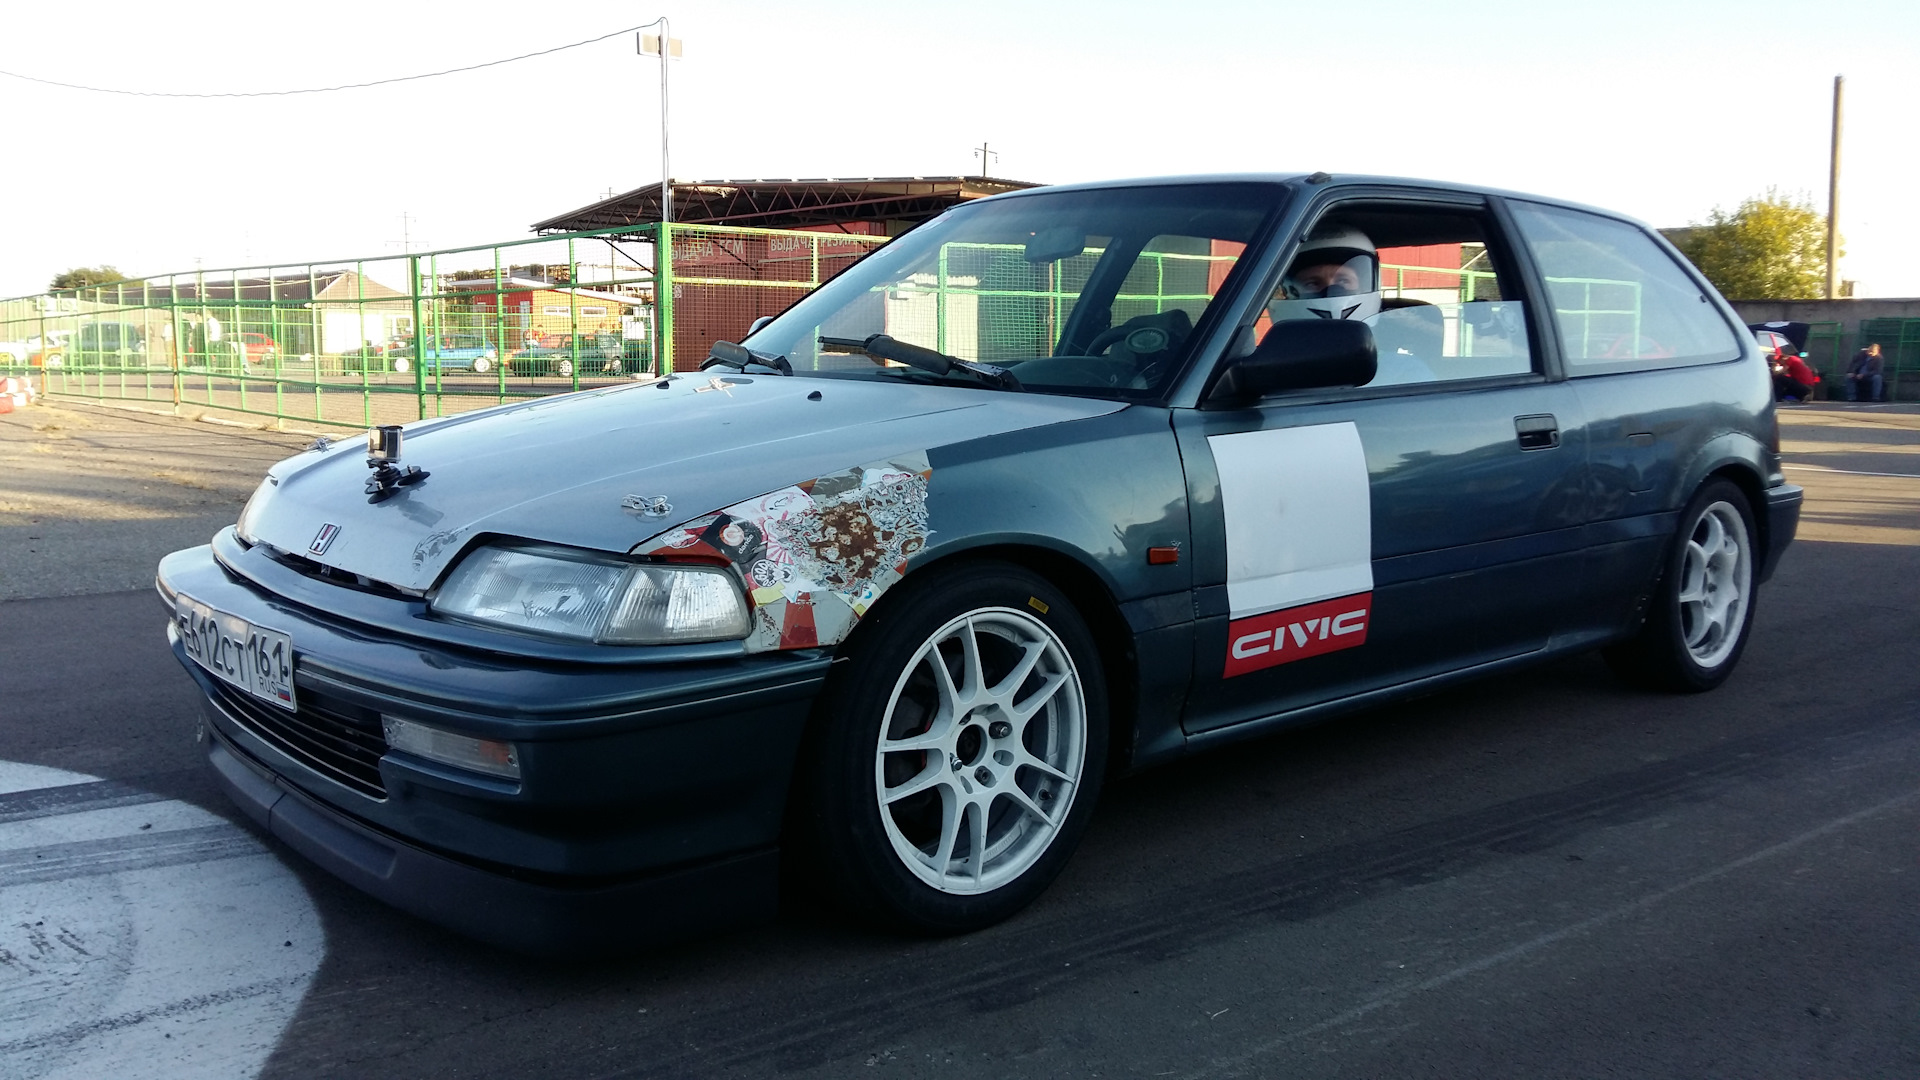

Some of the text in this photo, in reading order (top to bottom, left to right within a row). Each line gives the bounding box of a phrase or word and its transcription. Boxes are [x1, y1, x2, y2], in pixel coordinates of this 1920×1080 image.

[671, 239, 744, 261] ЫДАЧА ГСМ
[1232, 609, 1366, 660] CIVIC
[259, 676, 276, 696] RUS
